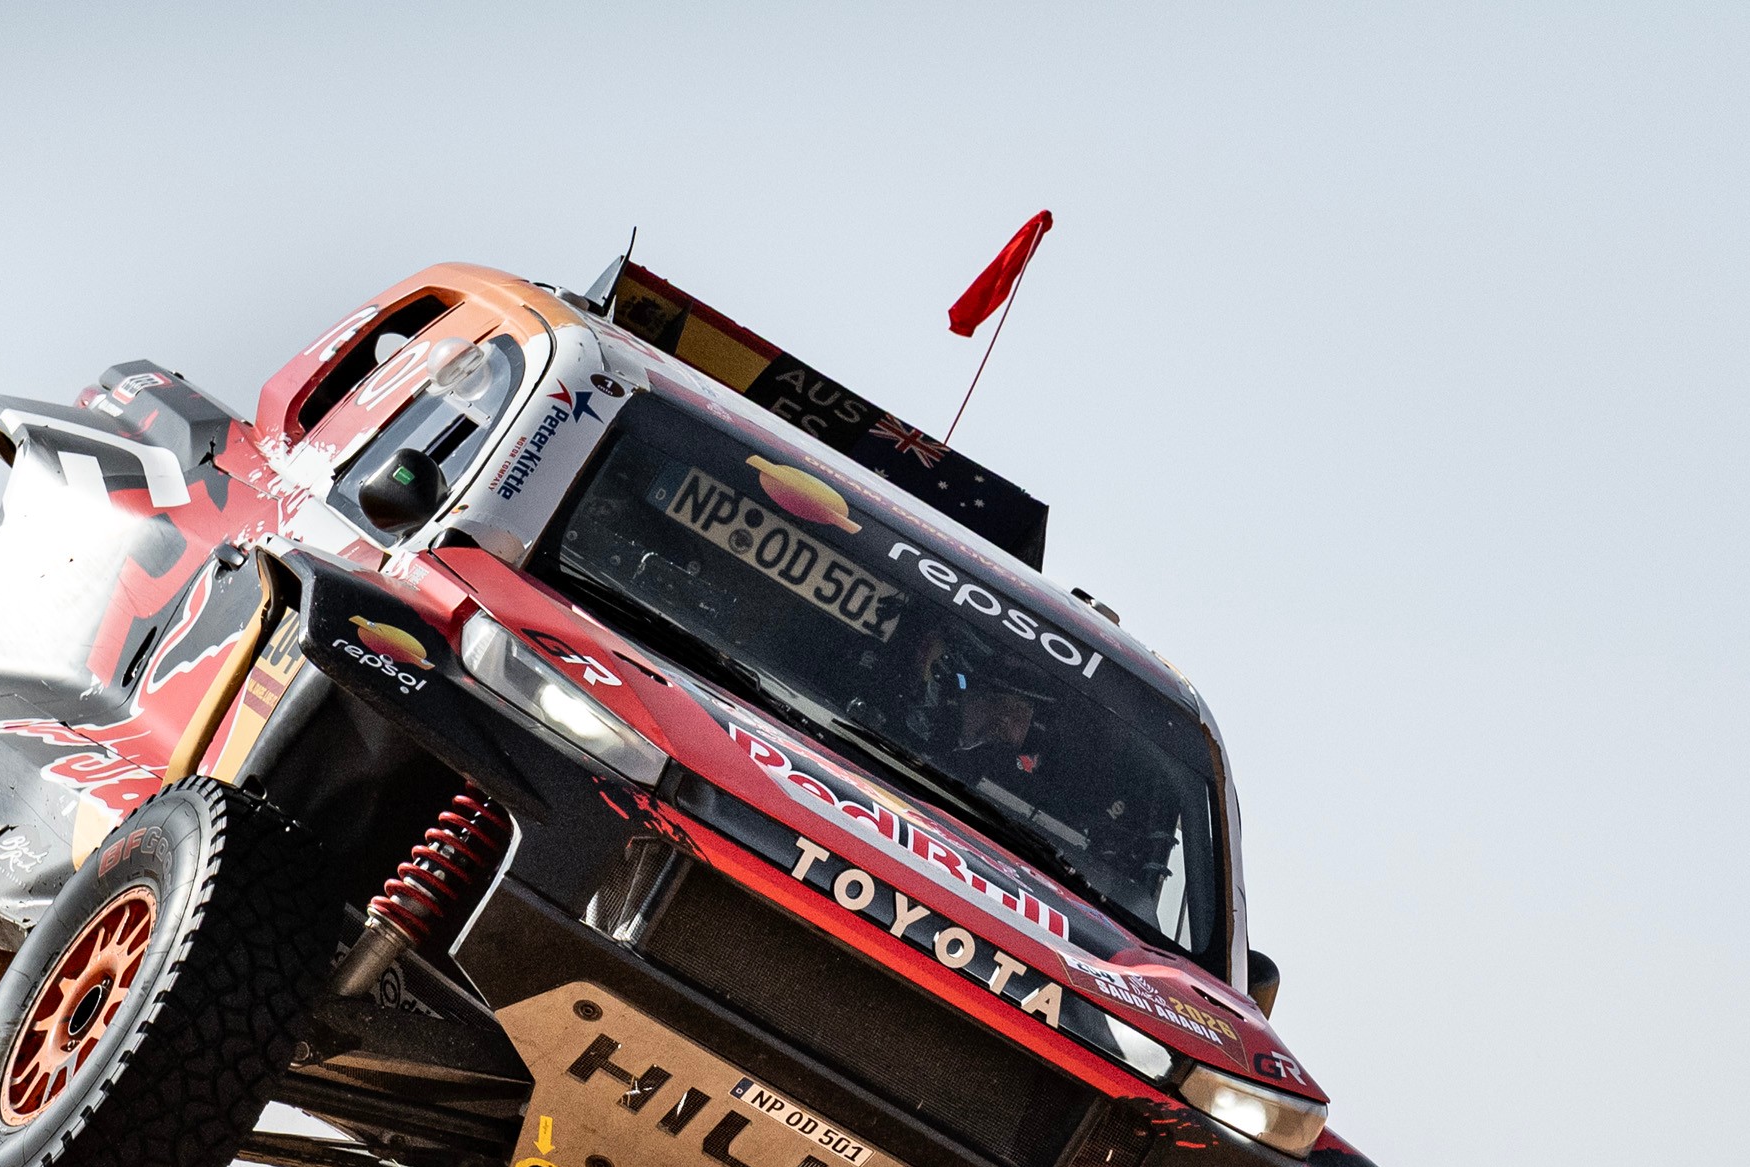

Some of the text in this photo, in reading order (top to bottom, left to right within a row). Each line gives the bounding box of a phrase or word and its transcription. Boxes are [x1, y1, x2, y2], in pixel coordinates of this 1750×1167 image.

[597, 384, 614, 395] min
[605, 379, 614, 388] 1
[775, 369, 868, 423] AUS
[489, 436, 527, 491] MOTOR COMPANY
[498, 405, 570, 500] Peter Kittle
[673, 474, 740, 532] NP
[888, 541, 1103, 679] repsol
[332, 639, 428, 691] repsol
[520, 628, 622, 686] GR
[791, 837, 1063, 1029] TOYOTA
[1095, 979, 1223, 1045] SAUDI ARABIA
[1168, 996, 1237, 1041] 2026
[735, 1087, 744, 1095] D
[1253, 1050, 1307, 1086] GR
[751, 1090, 864, 1162] NP OD 501
